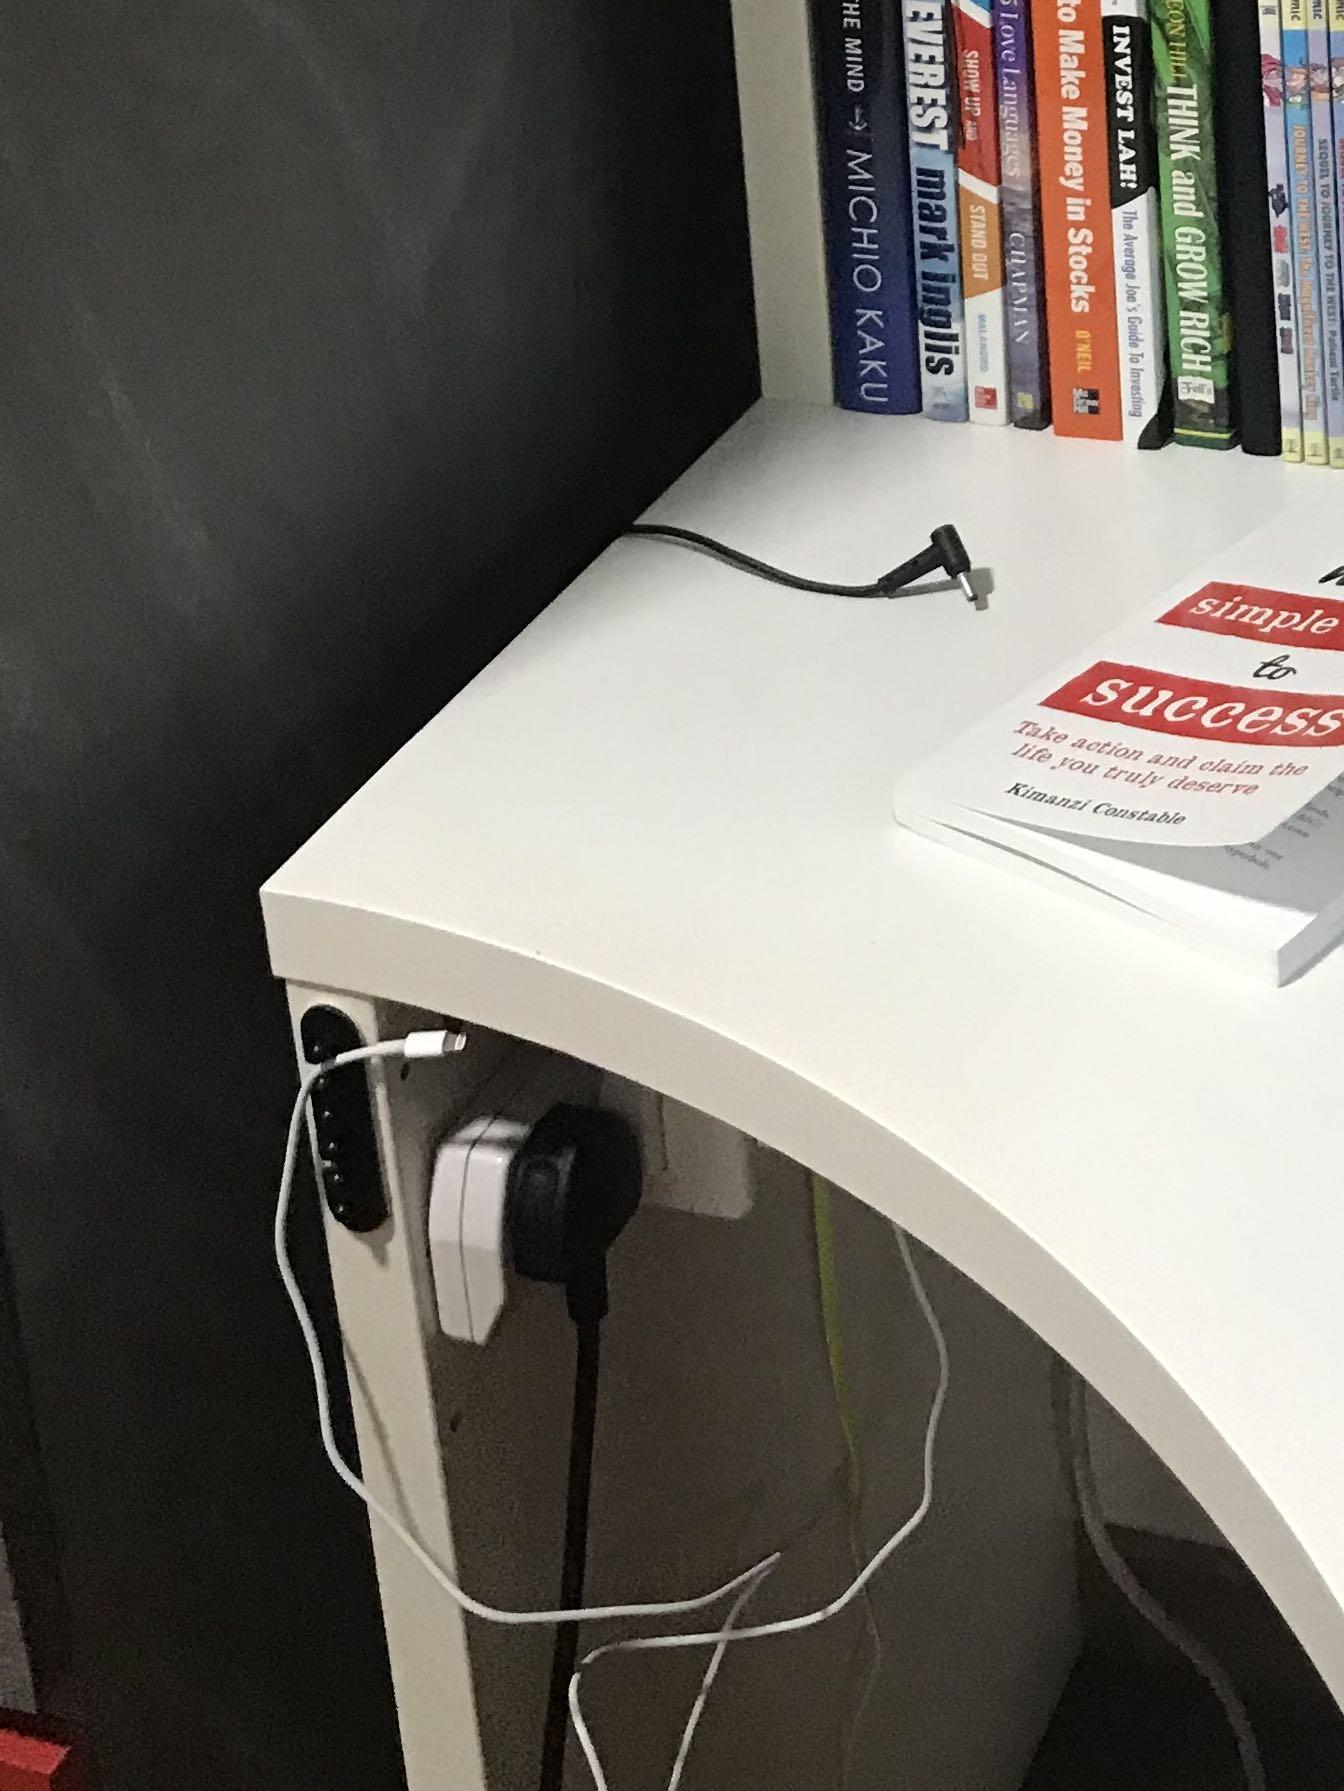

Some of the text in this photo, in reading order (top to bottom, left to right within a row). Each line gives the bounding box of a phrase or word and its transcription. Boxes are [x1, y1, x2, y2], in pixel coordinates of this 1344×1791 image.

[845, 37, 865, 92] MIND
[999, 13, 1020, 62] Love
[1058, 29, 1085, 100] Make
[1169, 42, 1188, 80] HILL
[904, 1, 949, 151] EVEREST
[962, 49, 980, 95] SHOW
[1112, 25, 1135, 123] INVEST
[1002, 68, 1022, 178] Languages
[1059, 106, 1088, 193] Money
[1166, 83, 1202, 161] THINK
[1117, 129, 1138, 189] LAH!
[1317, 138, 1330, 179] SEQUEL
[1066, 197, 1091, 221] in
[1171, 169, 1204, 218] and
[915, 168, 960, 376] mark inglis
[967, 204, 989, 282] STAND OUT
[1067, 228, 1096, 314] Stocks
[1174, 226, 1210, 304] GROW
[845, 149, 888, 403] MICHIO KAKU
[1005, 232, 1030, 344] CHAPMAN
[1121, 211, 1146, 418] The Average Joe's Guide Investing
[1178, 310, 1212, 373] RICH
[1074, 330, 1093, 373] O'NEIL
[1189, 595, 1340, 635] simple
[1252, 655, 1297, 681] to
[1012, 743, 1259, 795] life you truly deserve
[1013, 719, 1309, 776] Take action and claim the
[1005, 782, 1187, 825] Kimanzi Constable
